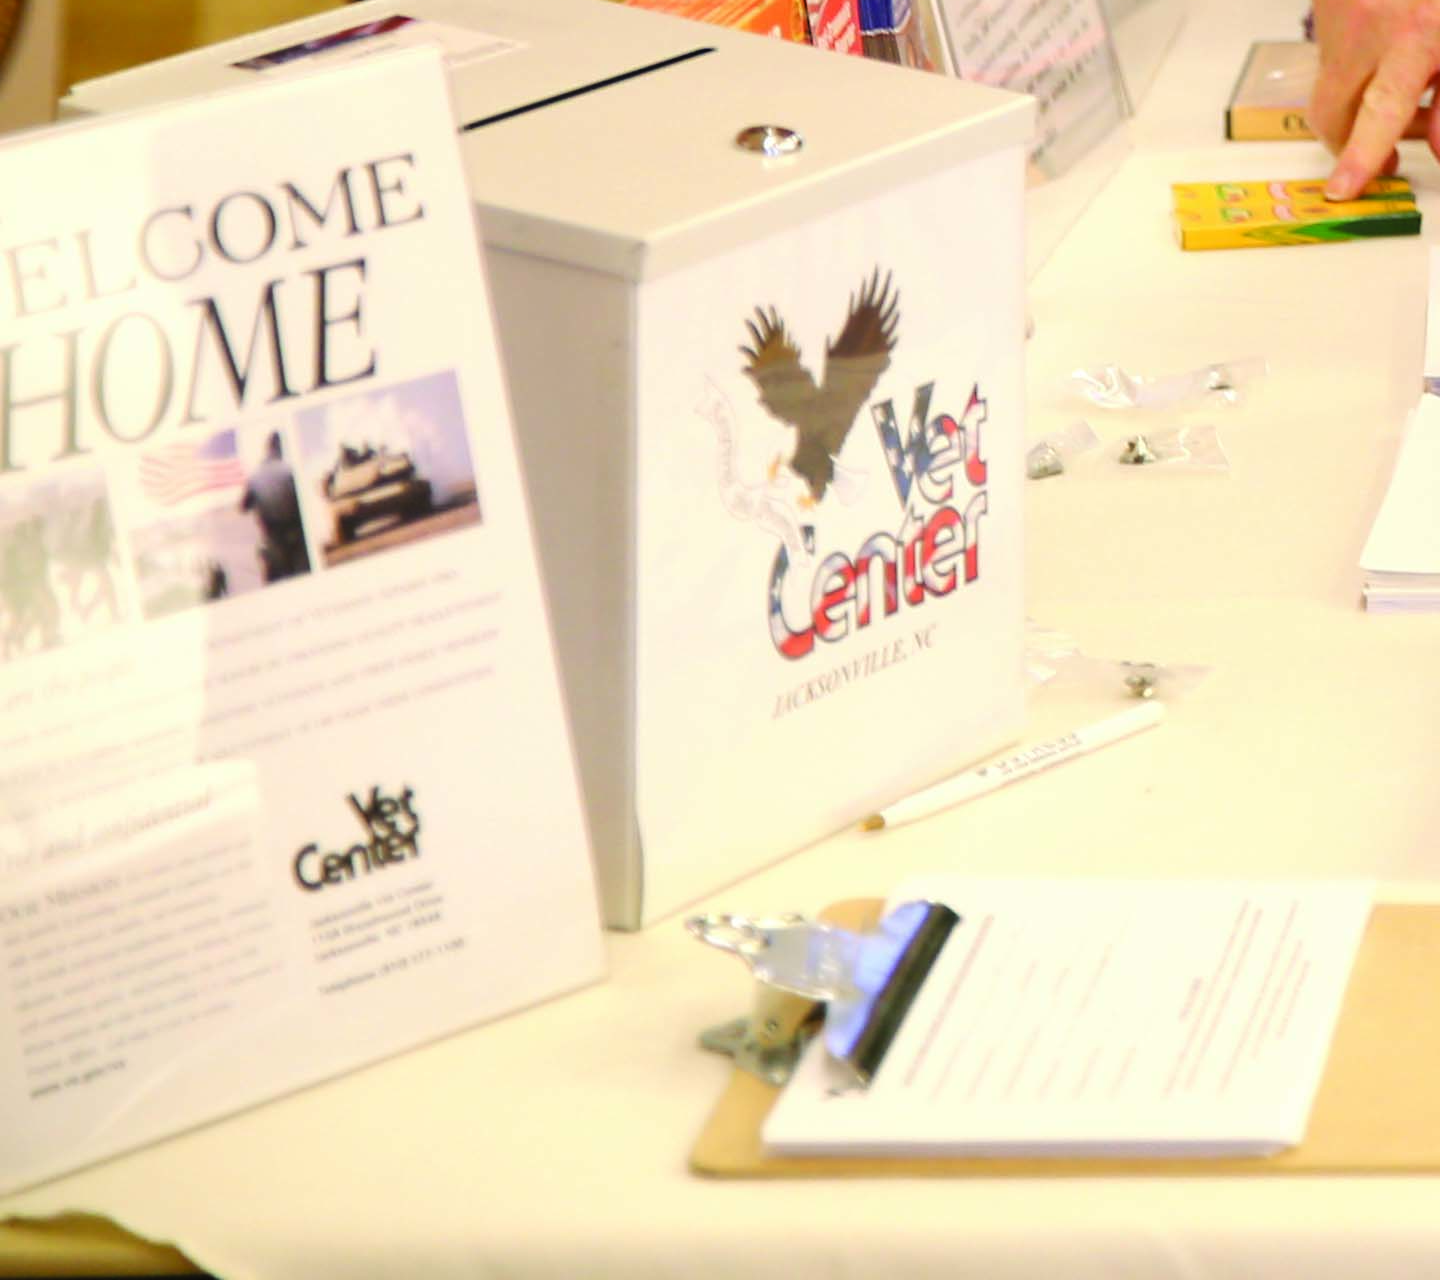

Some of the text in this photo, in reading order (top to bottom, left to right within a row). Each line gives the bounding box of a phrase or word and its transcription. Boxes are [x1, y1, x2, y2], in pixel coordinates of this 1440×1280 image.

[0, 152, 425, 320] ELCOME
[0, 257, 377, 470] HOME
[870, 380, 988, 507] Vet
[767, 490, 988, 662] Center
[293, 830, 421, 892] Center
[346, 784, 421, 838] Vet
